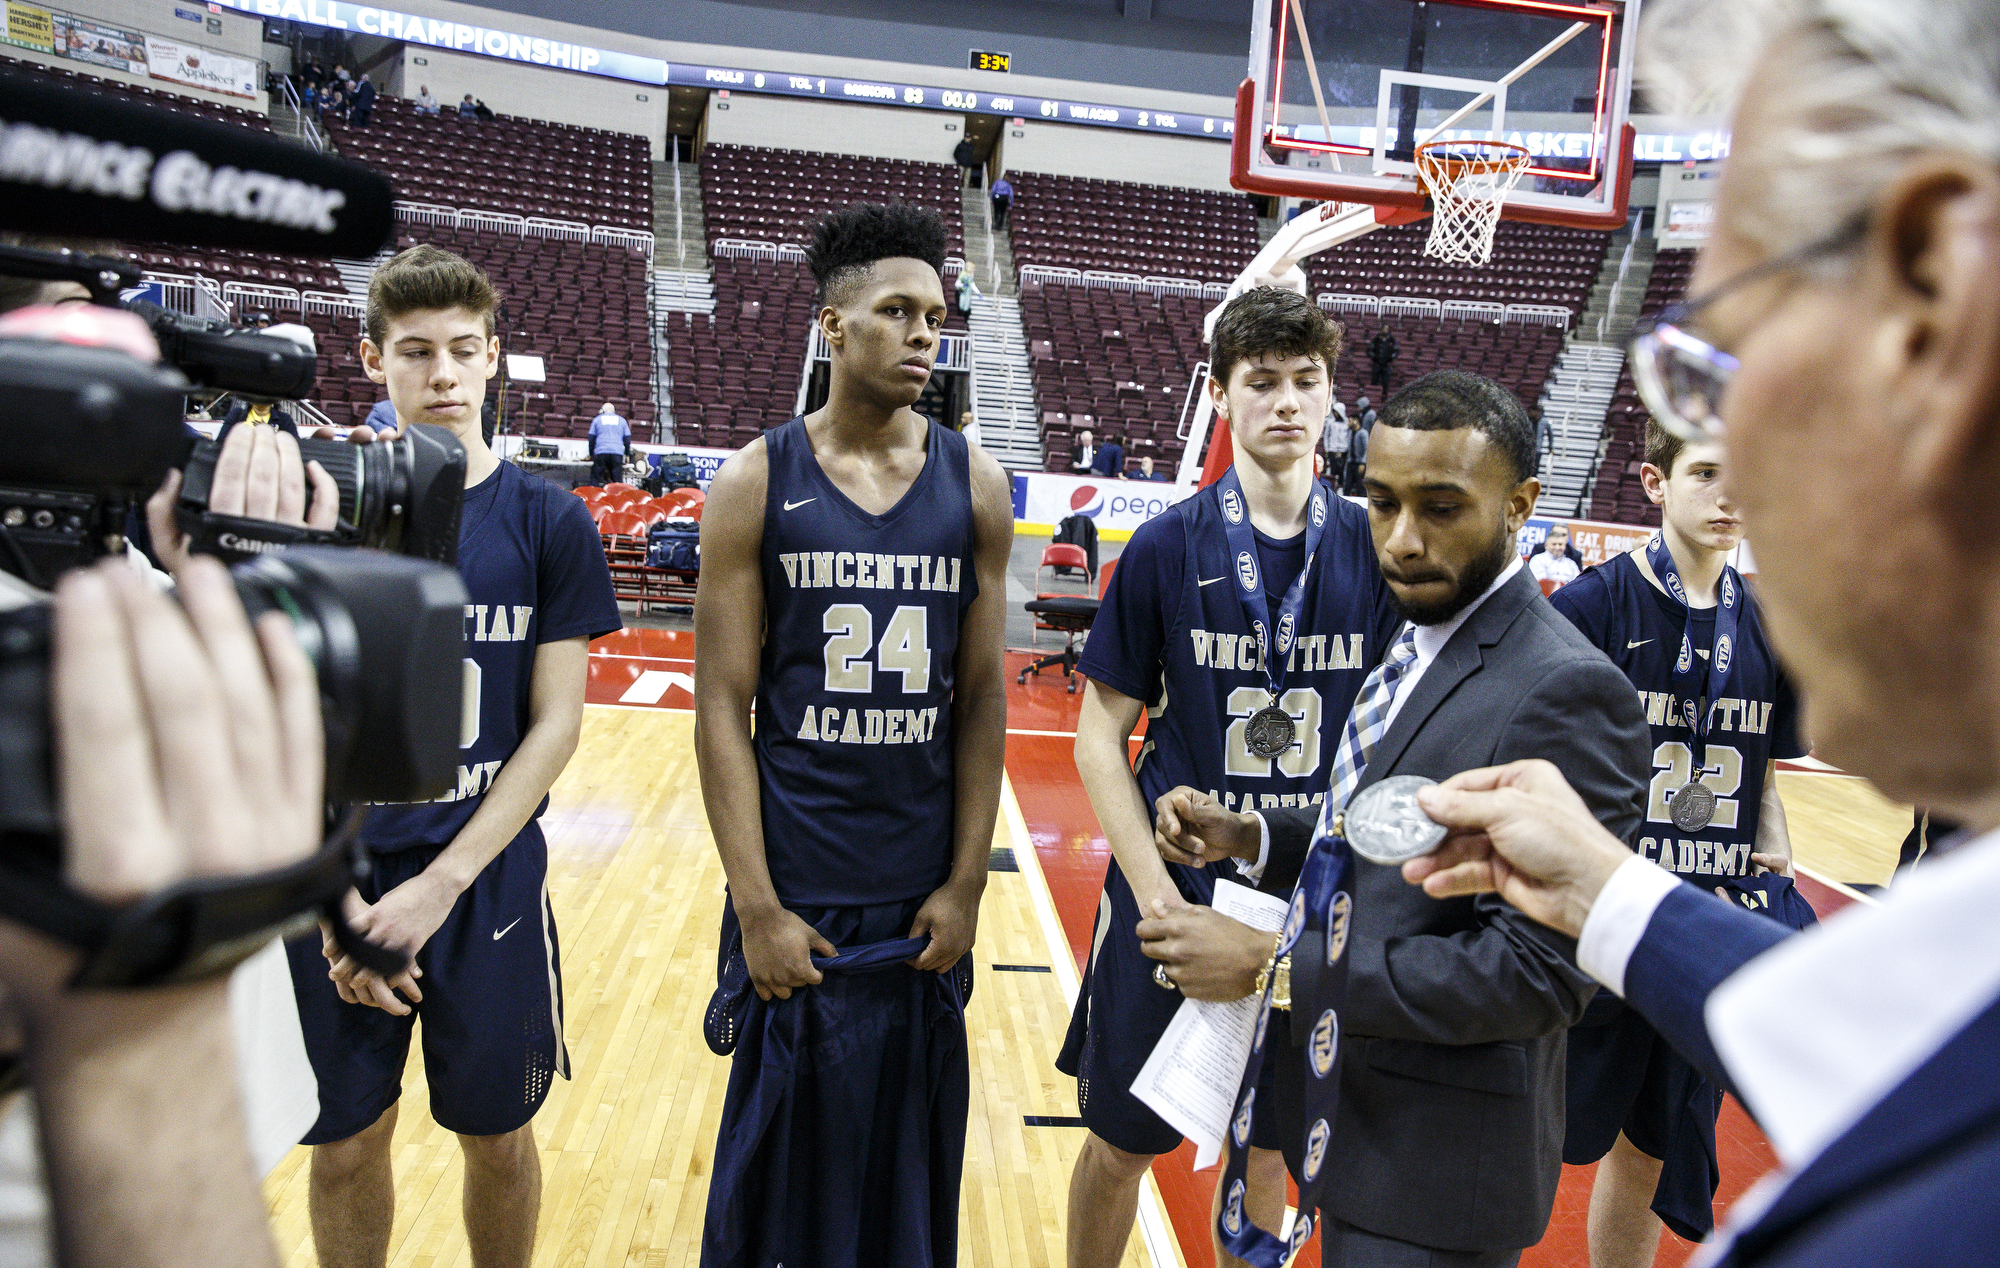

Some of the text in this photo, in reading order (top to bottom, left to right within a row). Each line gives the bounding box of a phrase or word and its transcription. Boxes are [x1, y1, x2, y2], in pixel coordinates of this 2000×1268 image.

[9, 15, 49, 31] HERSHEY
[356, 7, 601, 71] CHAMPIONSHIP
[177, 62, 236, 86] Applebee's
[979, 53, 1009, 70] 3:34
[706, 69, 745, 84] FOULS
[817, 79, 826, 94] 1
[941, 90, 978, 109] 00.0
[990, 97, 1014, 111] 4TH
[1137, 111, 1149, 126] 2
[1575, 531, 1601, 548] EAT.
[779, 552, 962, 592] VINCENTIAN
[1238, 552, 1256, 591] PIAA
[823, 603, 931, 694] 24
[1276, 614, 1294, 655] PIAA
[797, 705, 938, 744] ACADEMY
[1225, 686, 1322, 778] 23
[1646, 740, 1744, 829] 22
[1638, 836, 1751, 876] CADEMY
